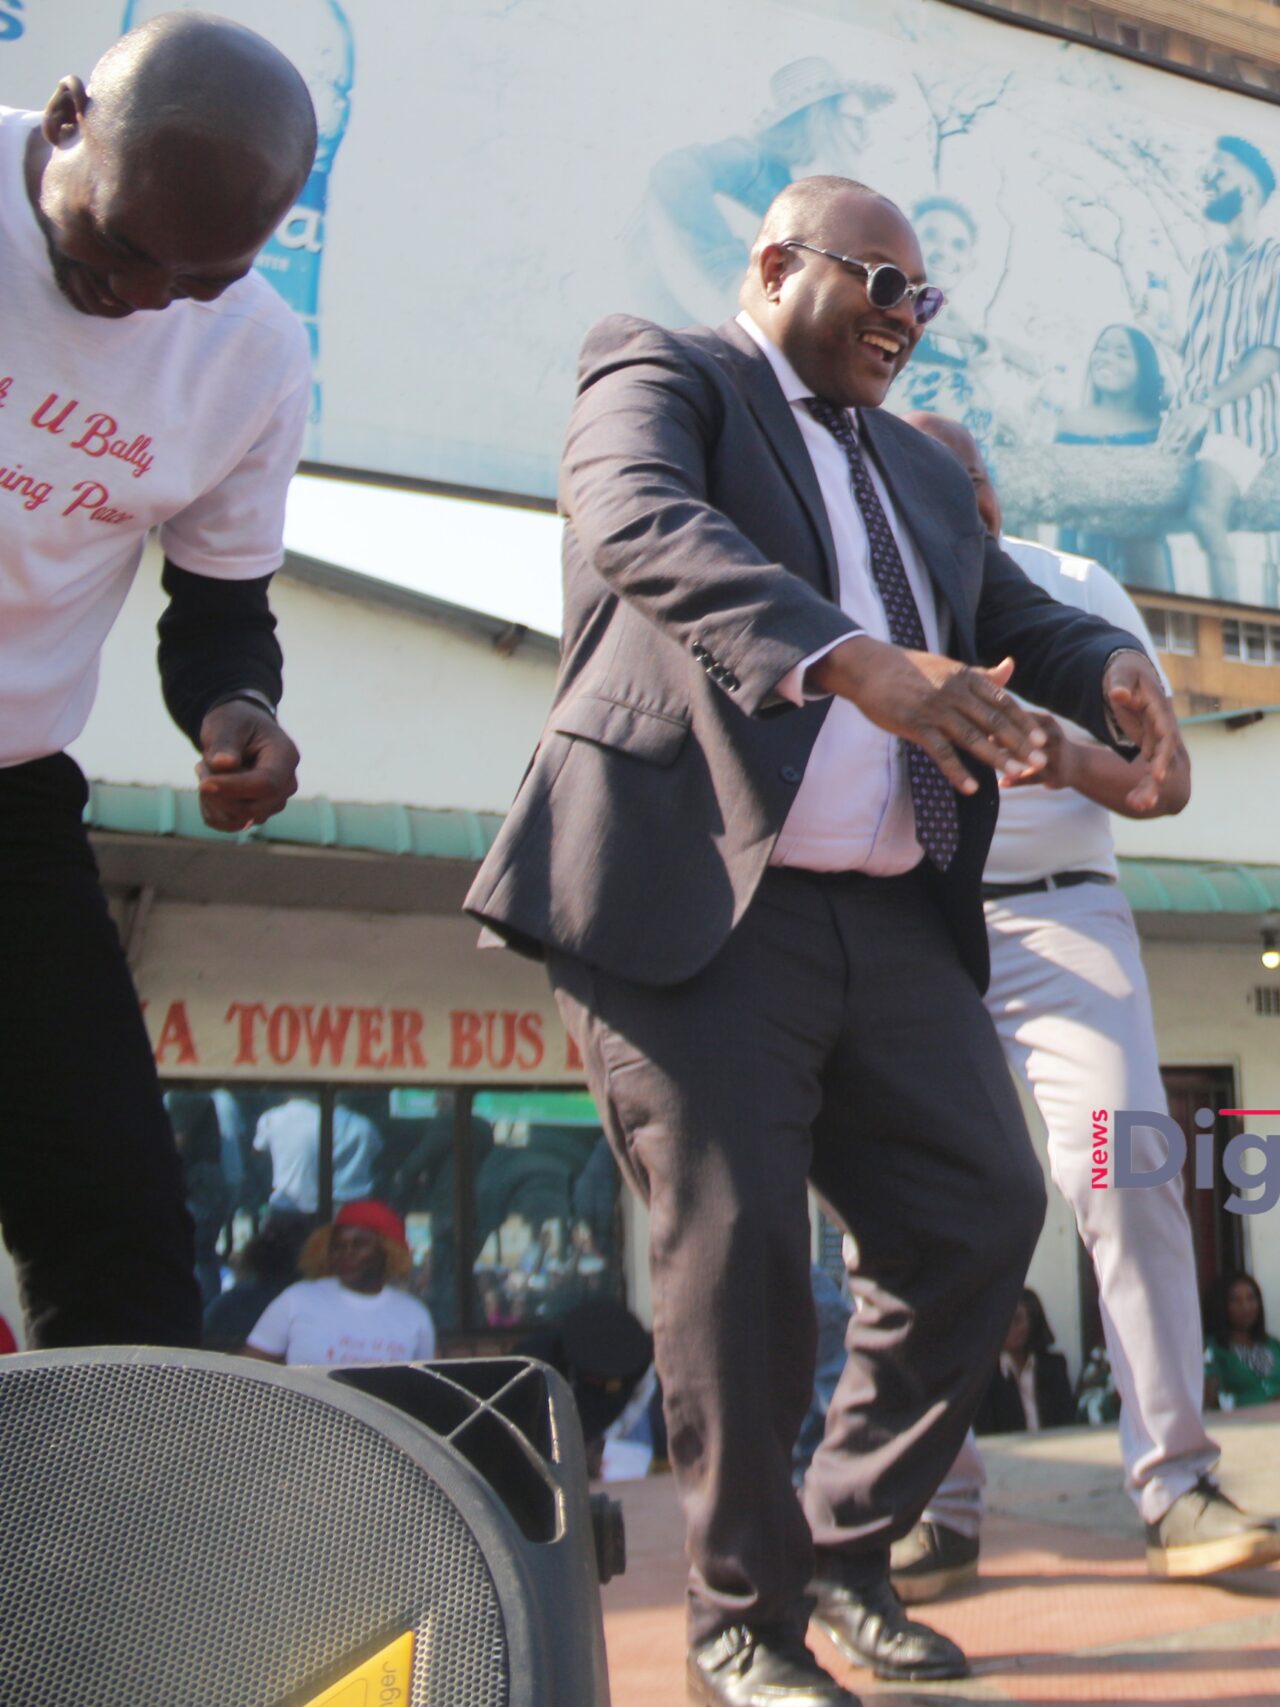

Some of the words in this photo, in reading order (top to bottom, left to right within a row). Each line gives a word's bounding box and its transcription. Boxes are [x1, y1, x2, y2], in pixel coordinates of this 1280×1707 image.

[31, 393, 79, 434] U
[70, 413, 154, 478] Bally
[139, 999, 199, 1066] A
[223, 1001, 426, 1071] TOWER
[449, 1010, 545, 1071] BUS
[379, 1660, 402, 1707] ger
